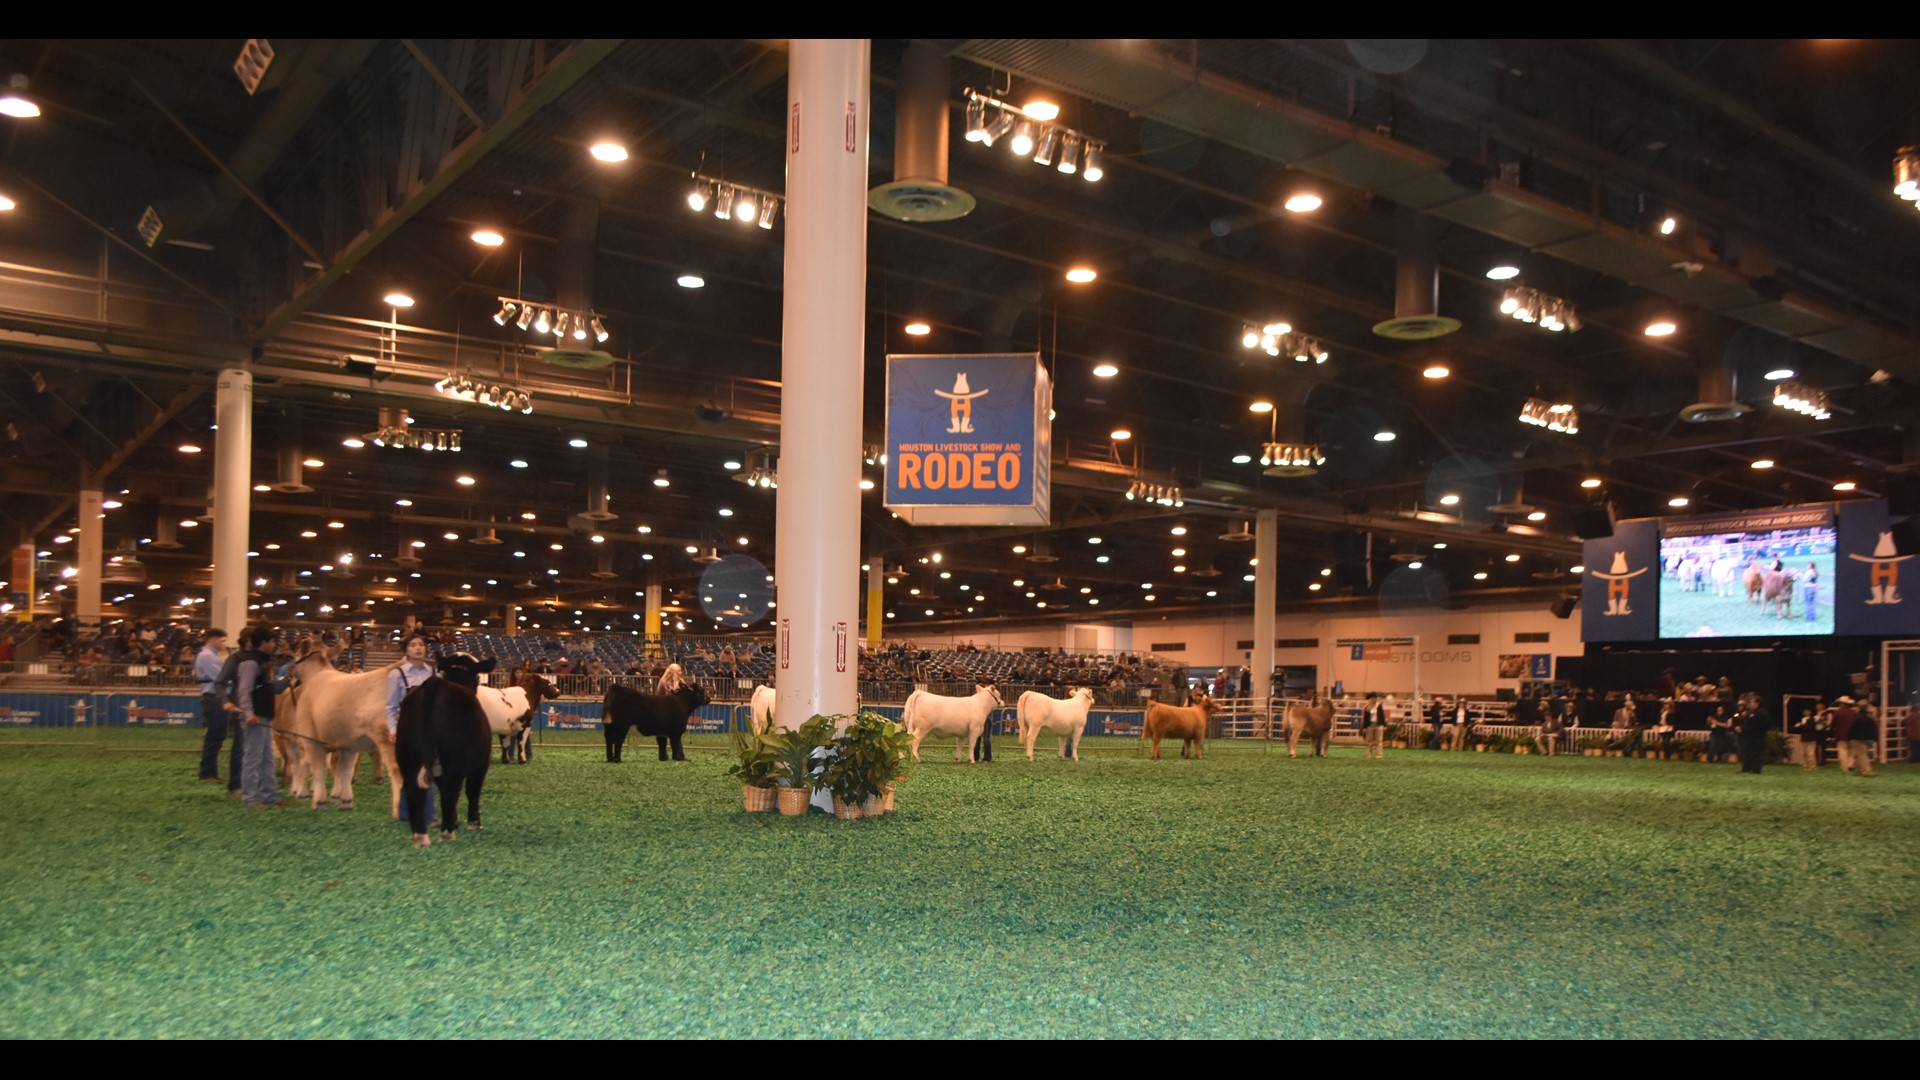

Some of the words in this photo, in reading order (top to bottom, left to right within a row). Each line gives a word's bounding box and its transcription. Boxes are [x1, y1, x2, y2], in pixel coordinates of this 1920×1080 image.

[899, 443, 934, 452] HOUSTON
[935, 443, 978, 452] LIVESTOCK
[980, 443, 1002, 452] SHOW
[1005, 443, 1021, 452] AND
[898, 452, 1021, 490] RODEO
